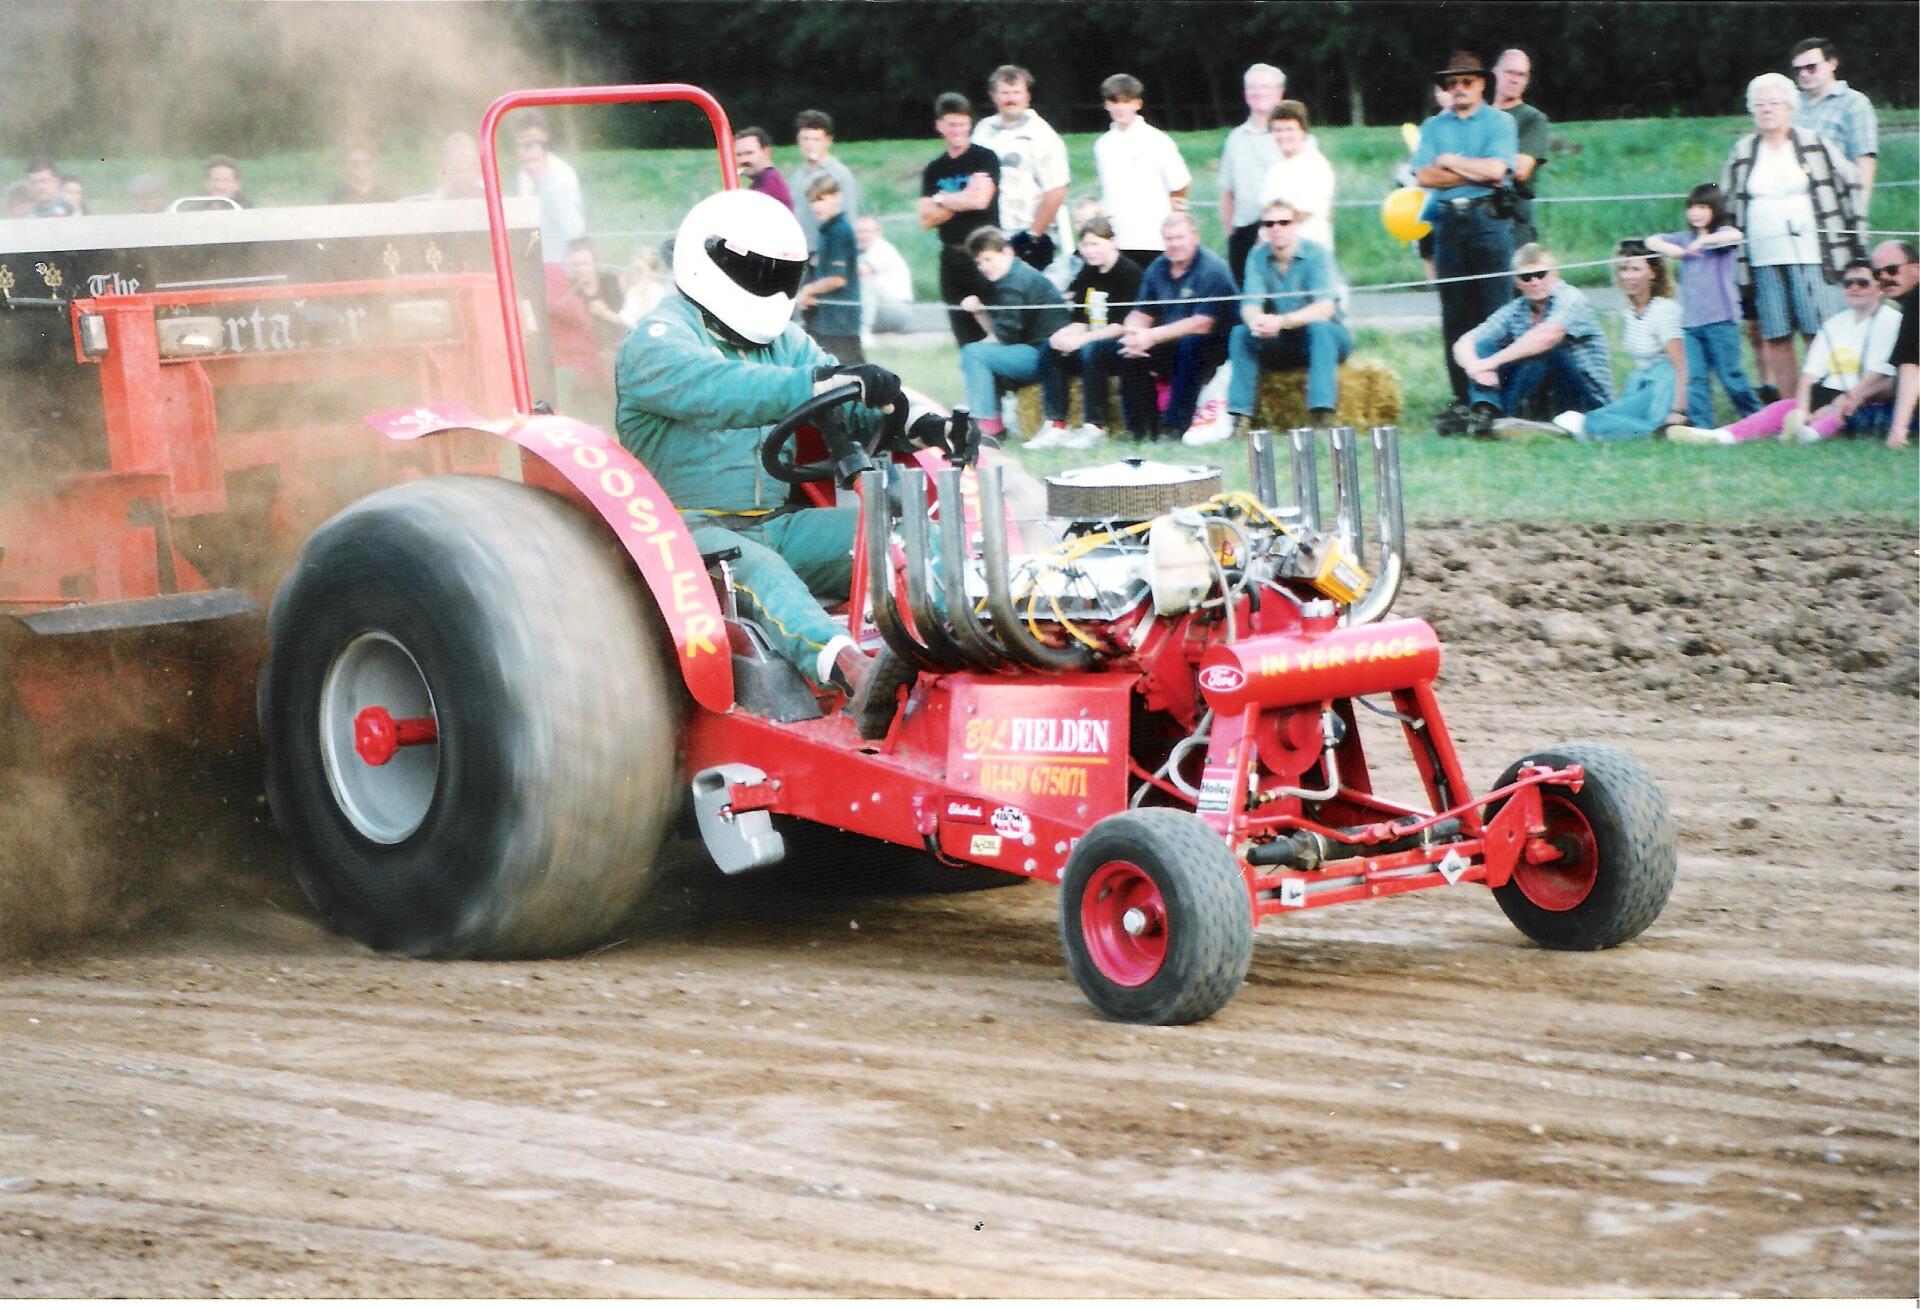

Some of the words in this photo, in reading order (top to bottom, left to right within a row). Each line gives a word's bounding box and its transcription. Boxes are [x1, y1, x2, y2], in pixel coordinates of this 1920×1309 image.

[87, 272, 140, 296] The
[544, 428, 717, 658] ROOSTER
[1261, 653, 1287, 677] IN
[1298, 645, 1346, 671] YER
[1354, 635, 1418, 663] FACE
[1206, 667, 1238, 688] Ford
[1010, 717, 1109, 753] FIELDEN
[980, 763, 1028, 793] 01449
[1030, 766, 1087, 797] 675071
